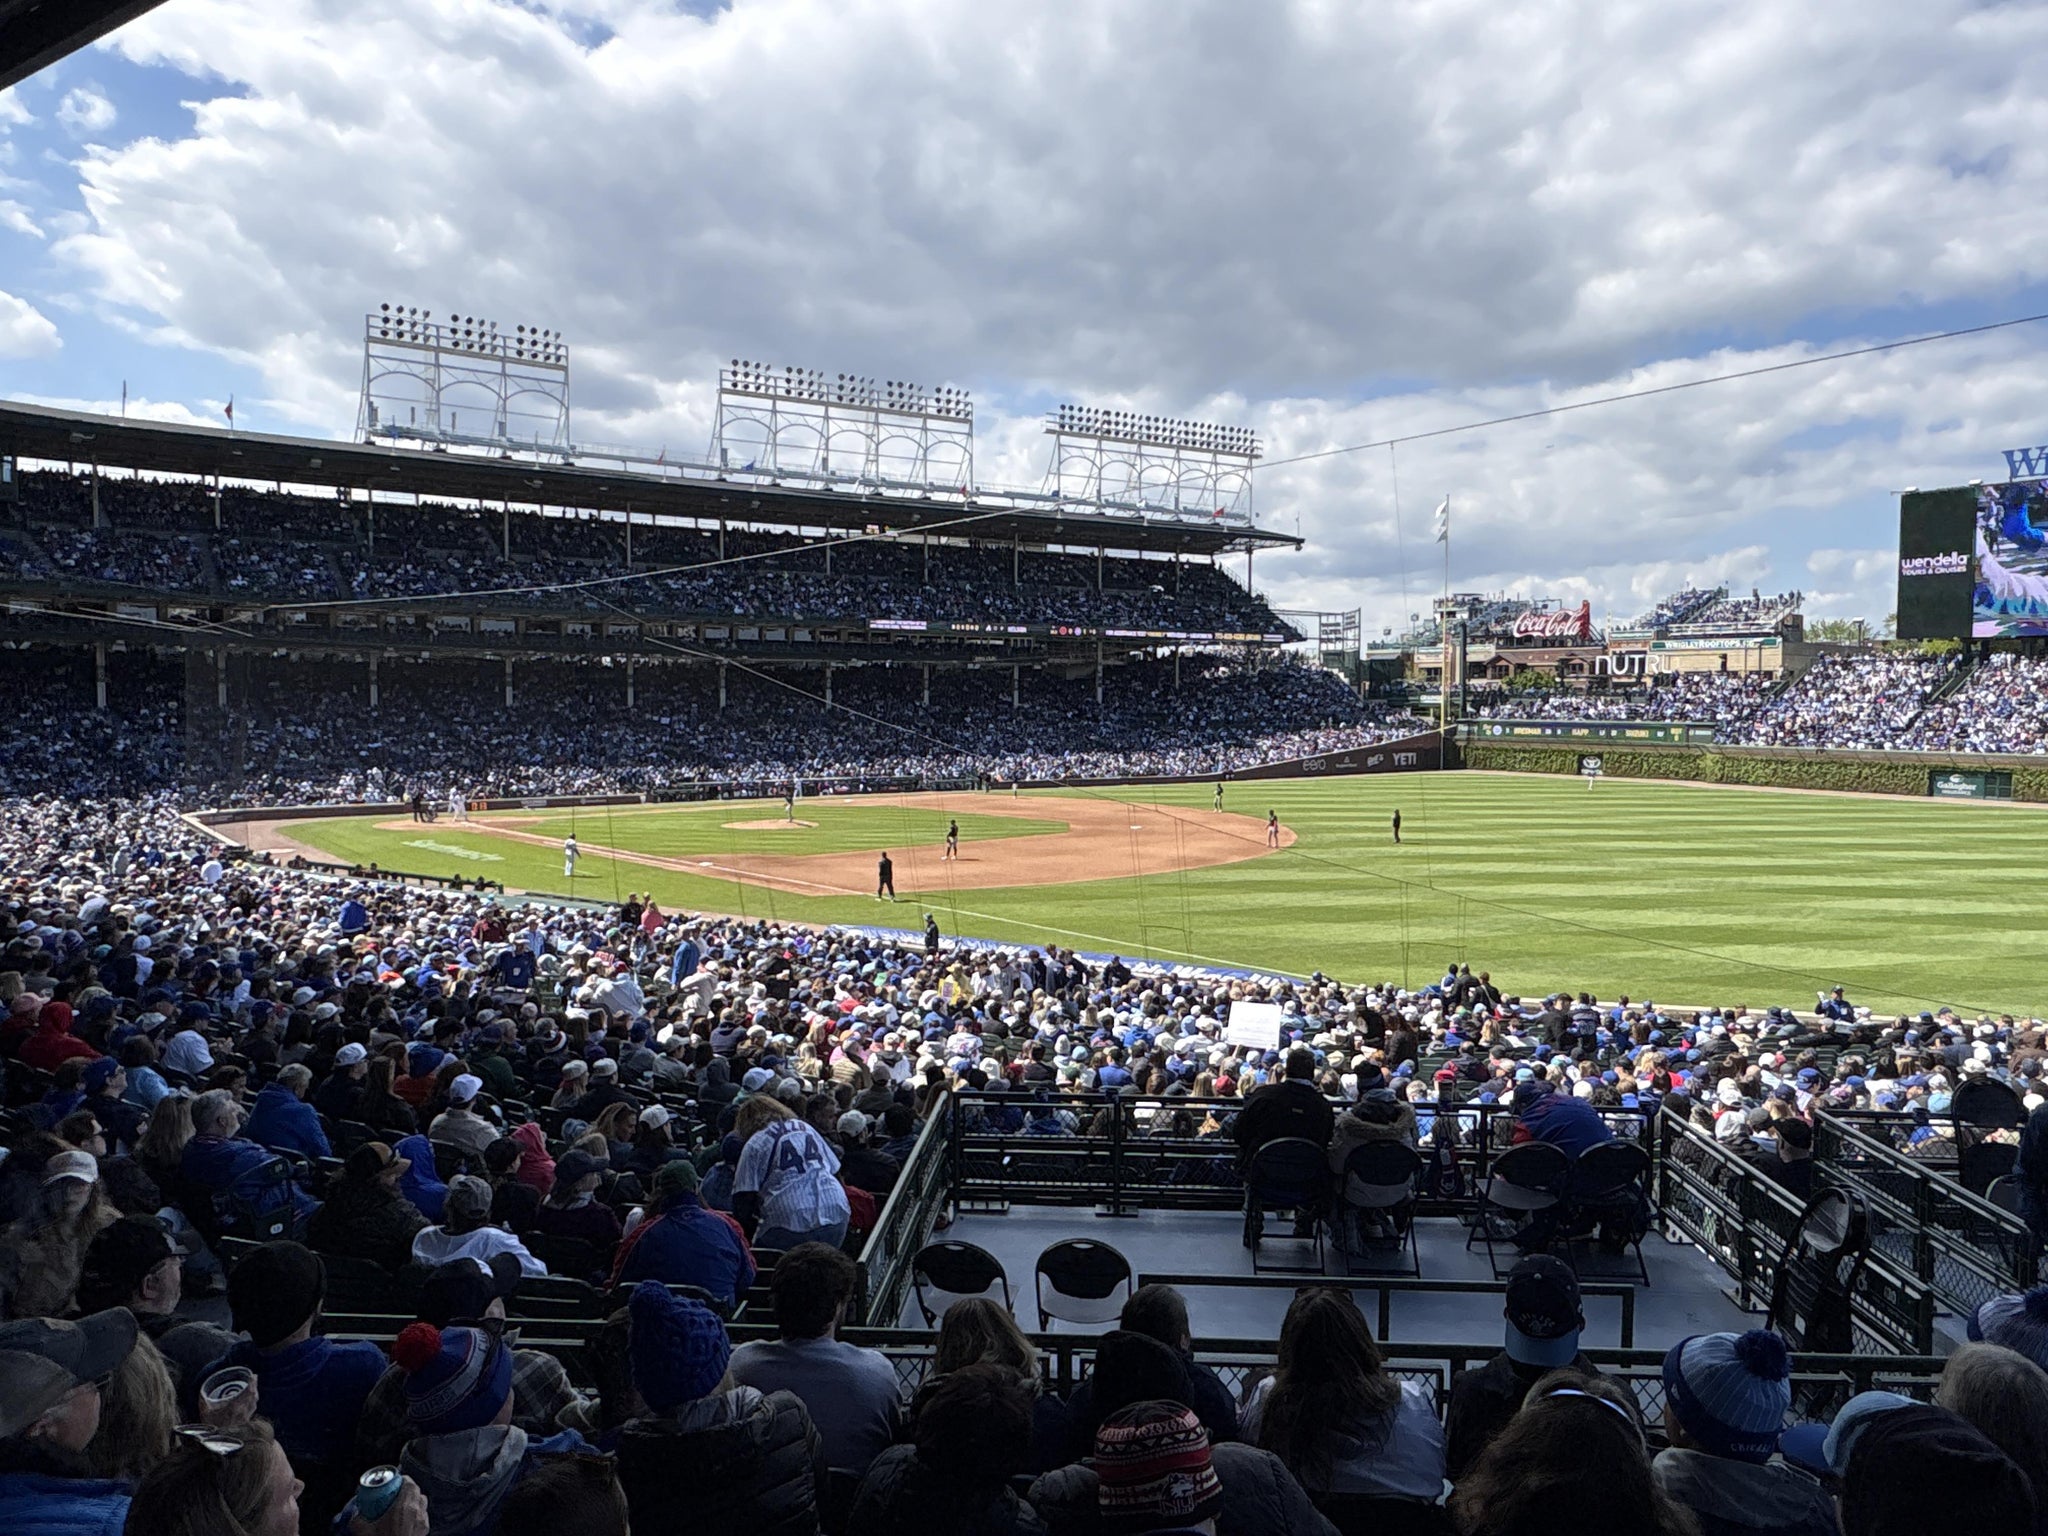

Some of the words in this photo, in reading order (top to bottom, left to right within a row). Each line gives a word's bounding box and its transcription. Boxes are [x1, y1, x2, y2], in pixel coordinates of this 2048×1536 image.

[1901, 551, 1968, 568] wendella
[1392, 752, 1417, 766] YETI
[779, 1133, 826, 1175] 44
